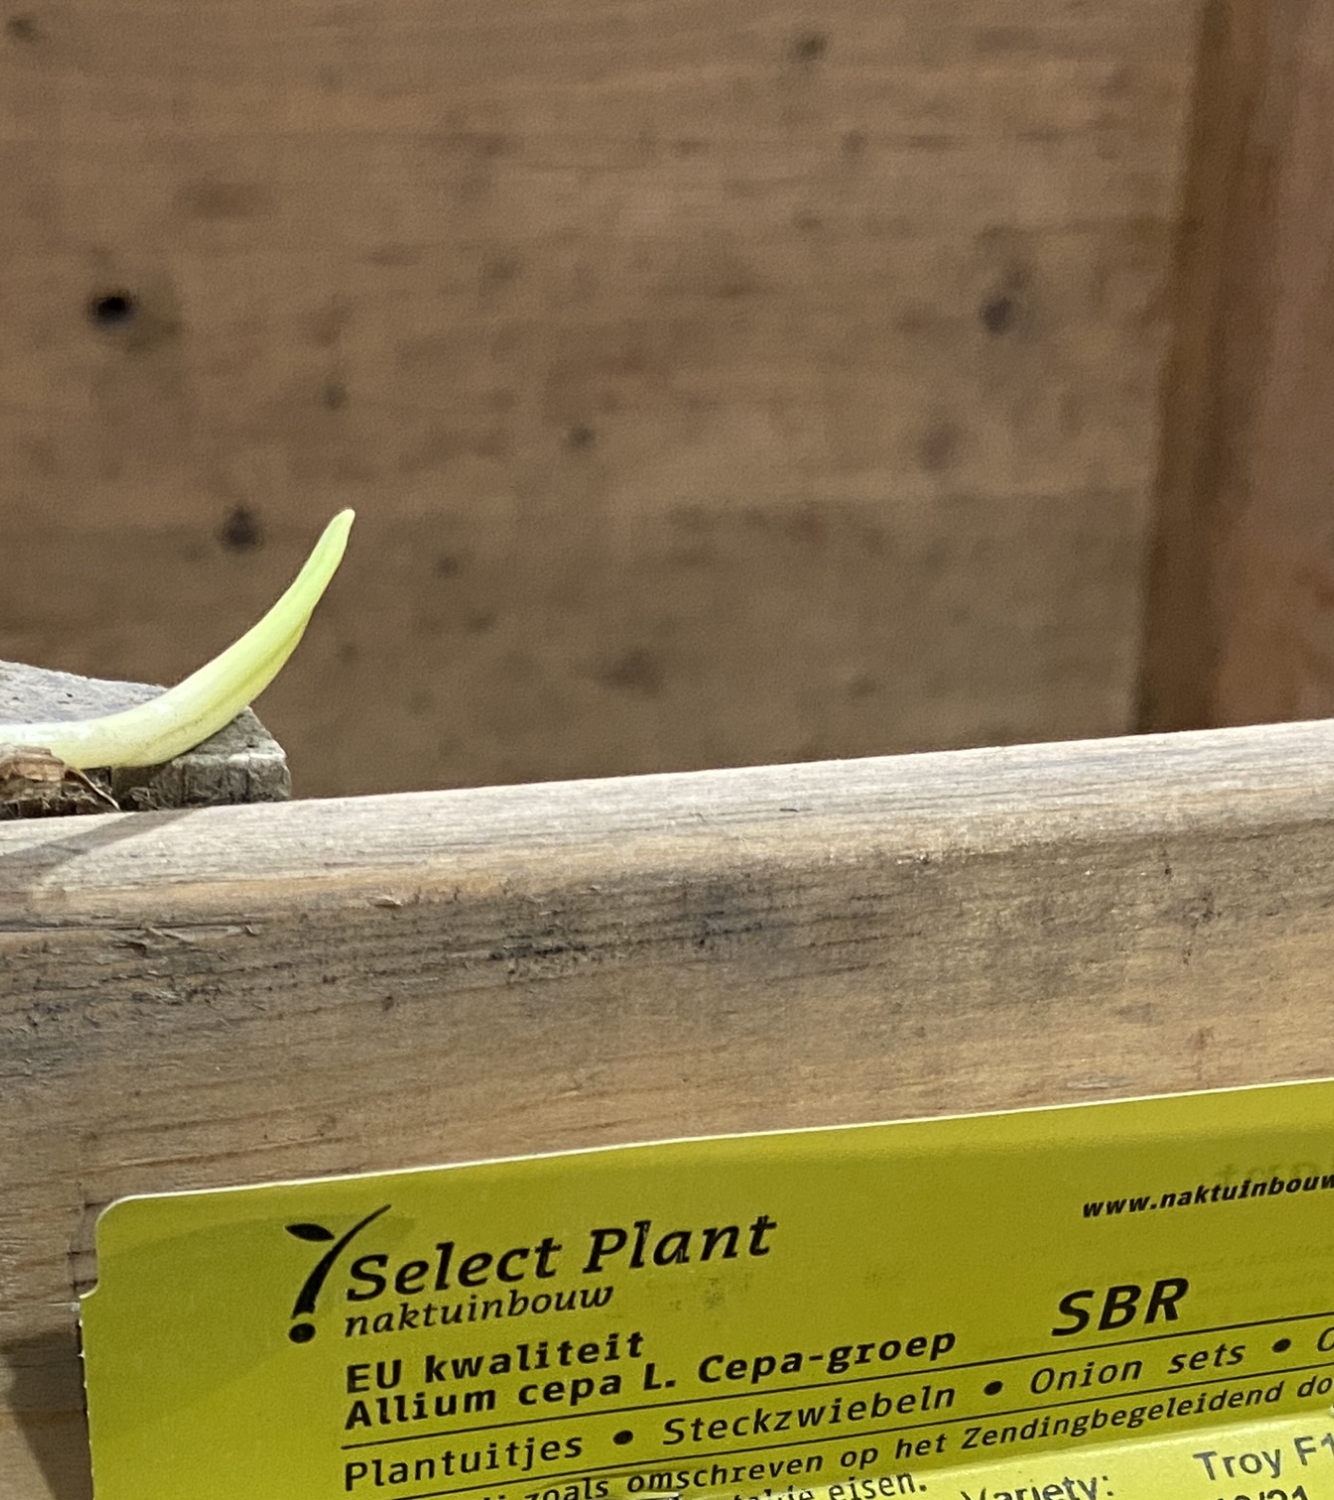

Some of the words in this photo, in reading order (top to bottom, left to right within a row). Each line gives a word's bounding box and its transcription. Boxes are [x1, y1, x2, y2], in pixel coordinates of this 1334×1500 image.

[346, 1237, 563, 1303] Select
[581, 1214, 778, 1275] Plant
[344, 1285, 615, 1338] naktuinbouw
[1051, 1277, 1190, 1337] SBR
[344, 1389, 497, 1431] Allium
[517, 1373, 623, 1416] cepa
[643, 1362, 677, 1391] L.
[698, 1332, 956, 1385] Cepa-groep
[346, 1358, 402, 1395] EU
[424, 1331, 644, 1384] kwaliteit
[345, 1436, 583, 1492] Plantuitjes
[662, 1381, 956, 1445] Steckzwiebeln
[1030, 1360, 1143, 1395] Onion
[1166, 1343, 1247, 1375] sets
[627, 1454, 824, 1493] omschreven
[840, 1447, 879, 1471] op
[894, 1433, 948, 1460] het
[961, 1378, 1282, 1451] Zendingbegeleidend
[1192, 1448, 1281, 1481] Troy
